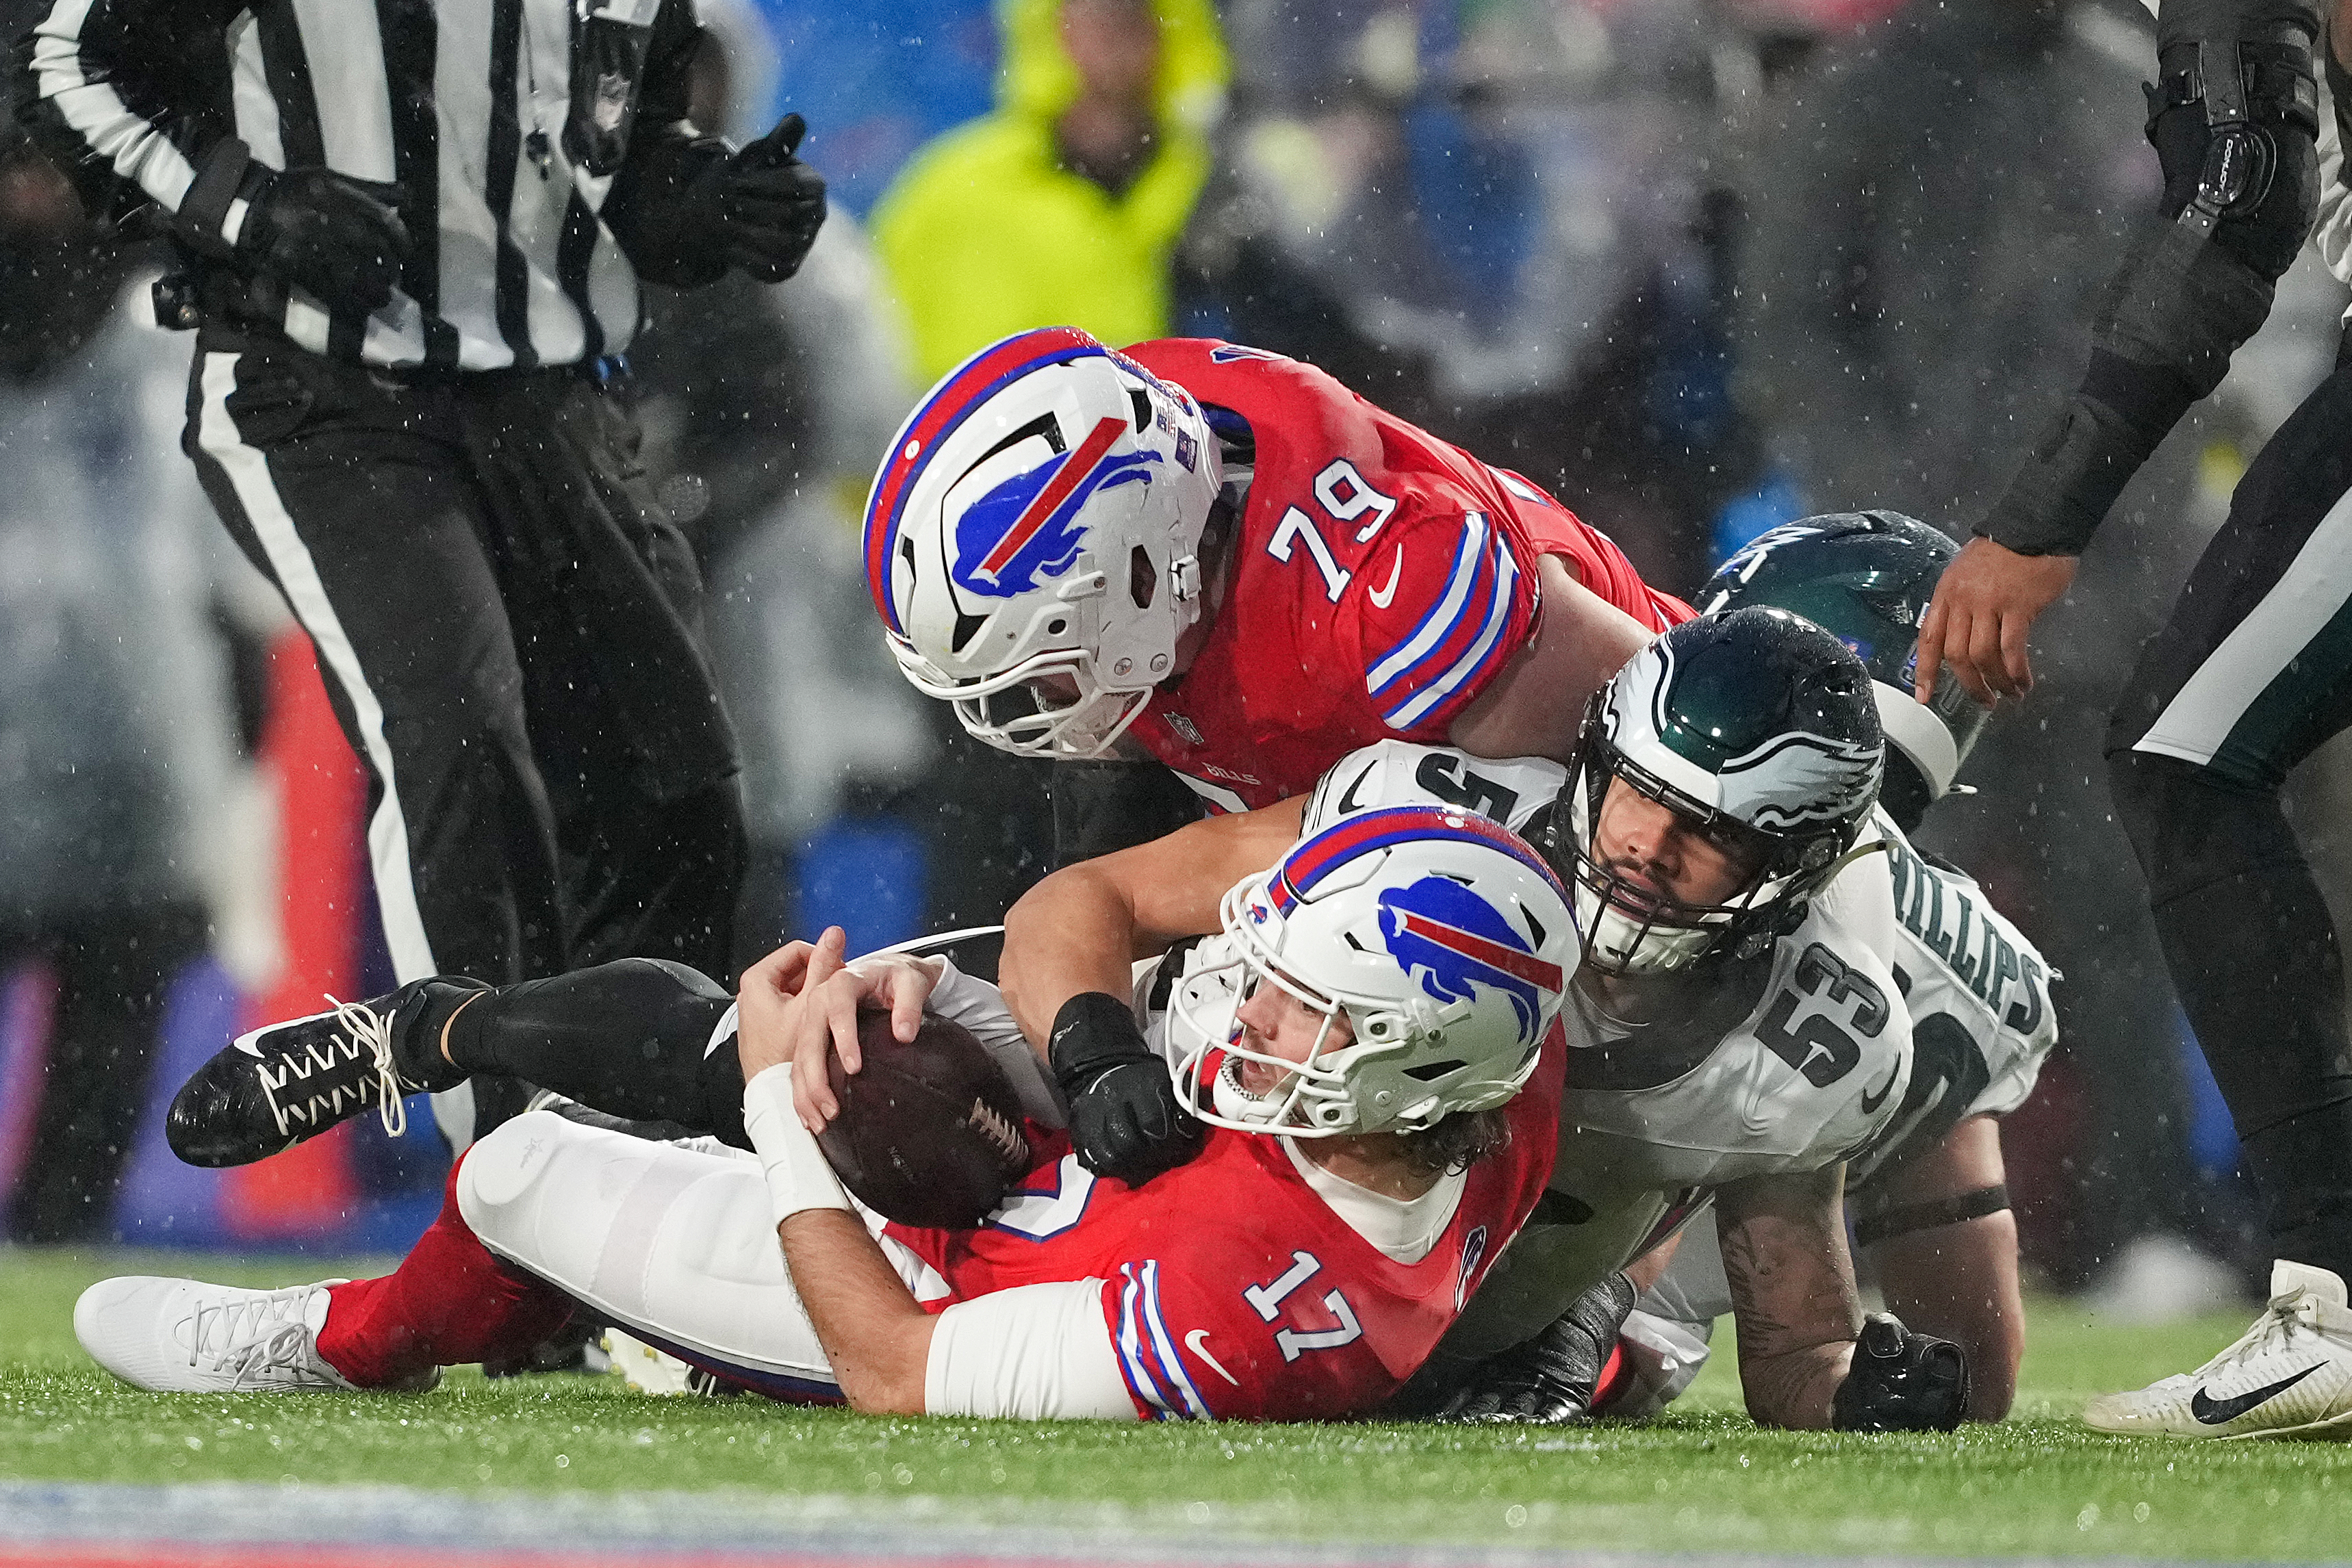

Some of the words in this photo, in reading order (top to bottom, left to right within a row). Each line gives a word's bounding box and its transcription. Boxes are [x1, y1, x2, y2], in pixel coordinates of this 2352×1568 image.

[1268, 458, 1396, 604] 79
[1416, 753, 1519, 825] 5
[1754, 942, 1891, 1088] 53
[1242, 1250, 1363, 1363] 17
